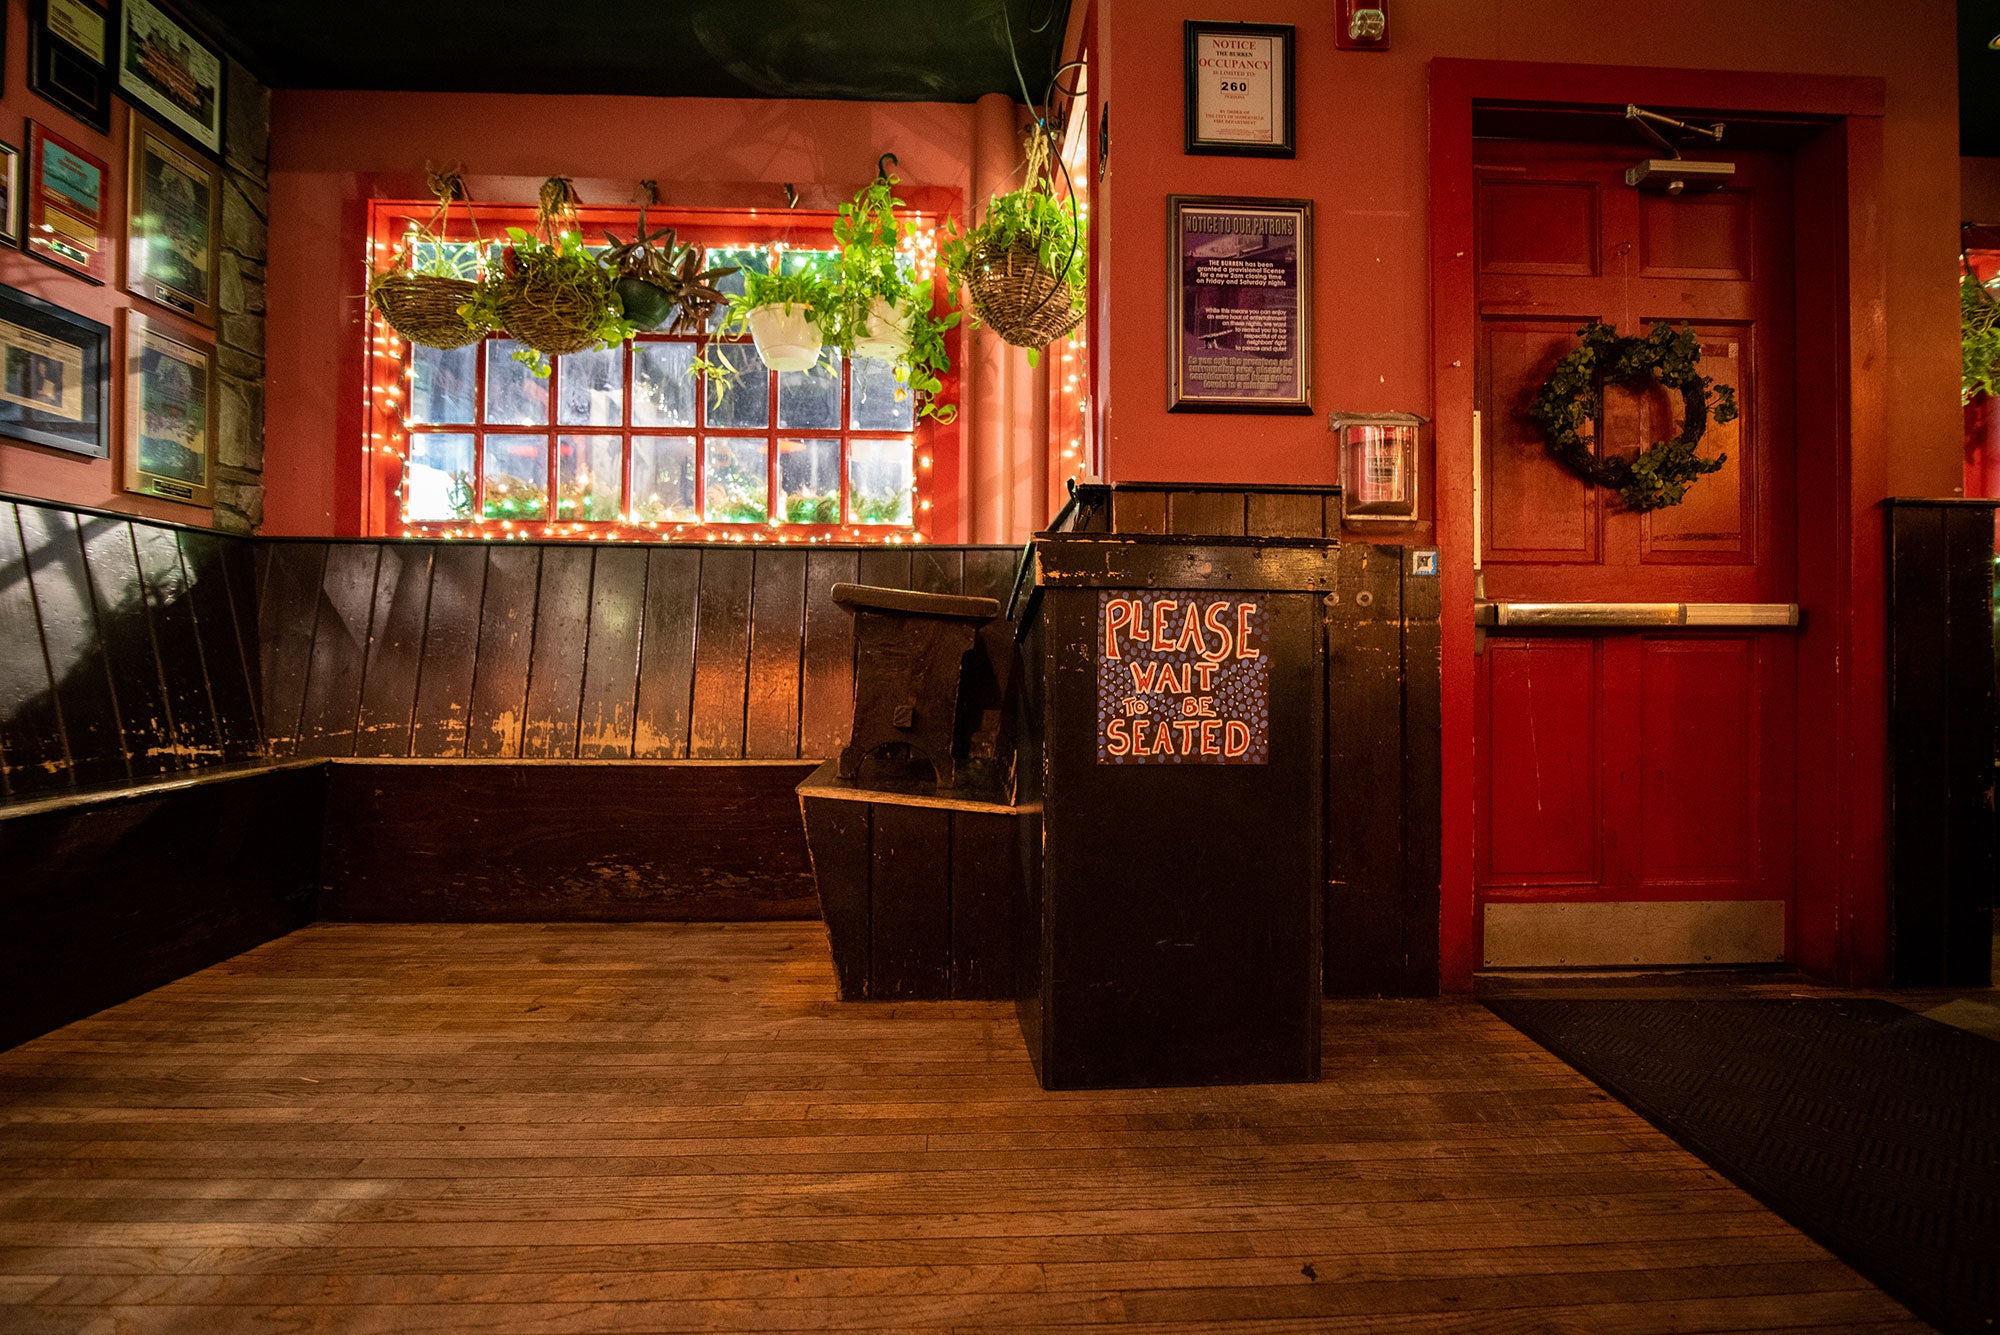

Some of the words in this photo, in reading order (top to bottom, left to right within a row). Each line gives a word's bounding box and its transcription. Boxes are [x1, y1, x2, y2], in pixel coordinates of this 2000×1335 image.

[1212, 39, 1257, 51] NOTICE
[1198, 58, 1270, 70] OCCUPANCY
[1221, 81, 1247, 92] 260
[1185, 215, 1219, 234] NOTICE
[1219, 216, 1232, 234] TO
[1233, 217, 1252, 235] OUR
[1253, 217, 1295, 236] PATRONS
[1208, 259, 1220, 267] THE
[1205, 278, 1225, 286] Friday
[1239, 279, 1267, 287] Saturday
[1267, 279, 1287, 288] nights
[1244, 273, 1268, 281] closing
[1105, 598, 1260, 662] PLEASE
[1129, 661, 1219, 695] WAIT
[1122, 696, 1149, 717] TO
[1181, 696, 1217, 718] BE
[1106, 718, 1251, 757] SEATED
